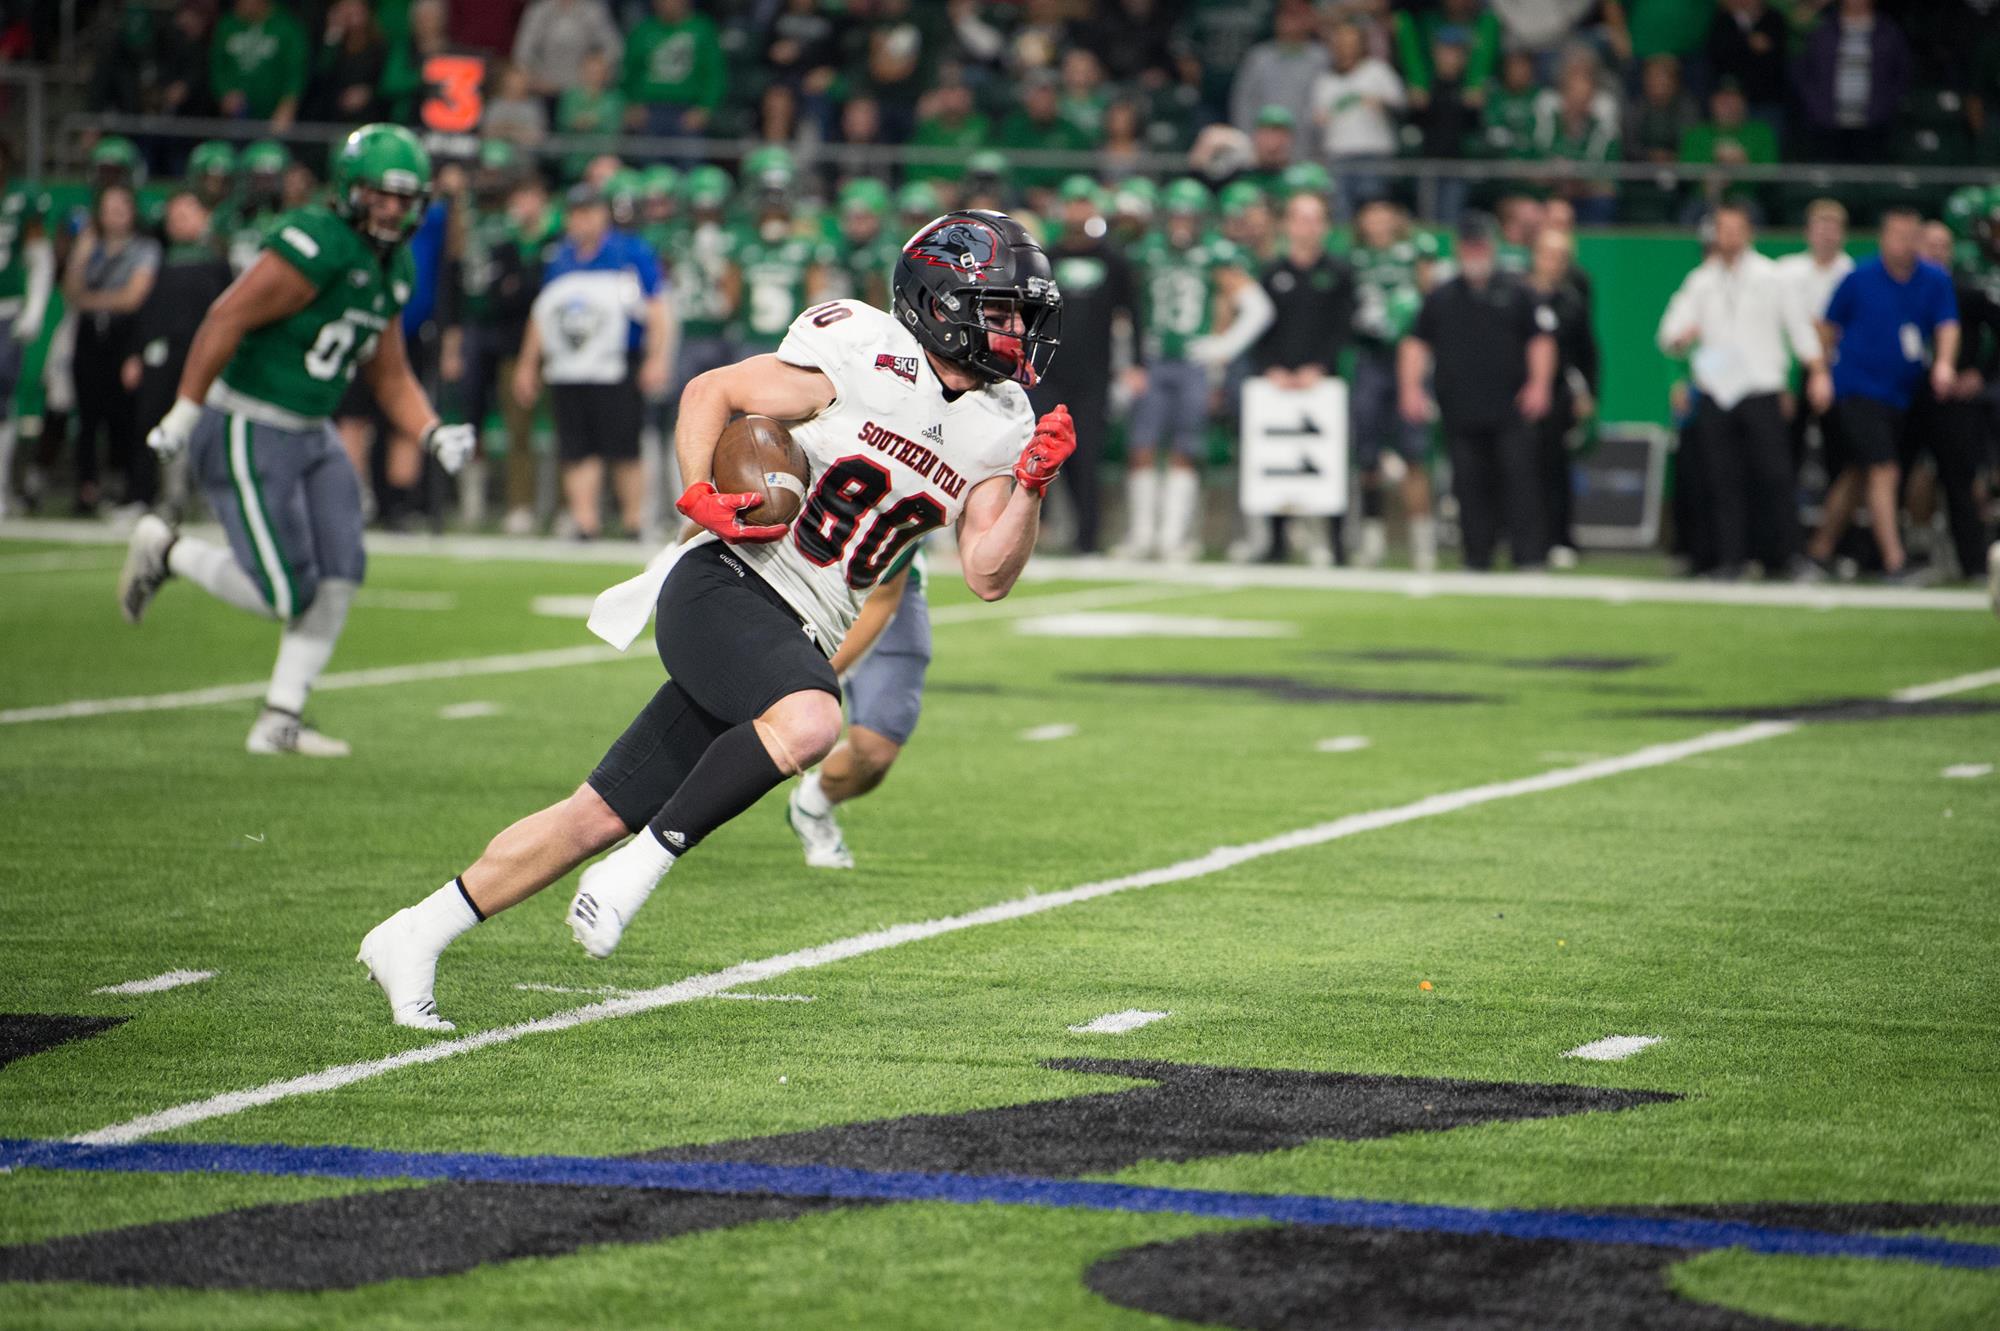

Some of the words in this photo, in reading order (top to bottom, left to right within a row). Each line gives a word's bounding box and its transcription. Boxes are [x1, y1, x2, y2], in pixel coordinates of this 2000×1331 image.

[421, 56, 484, 132] 3
[858, 421, 940, 478] SOUTHERN
[932, 461, 968, 500] UTAH
[921, 429, 944, 446] adidas
[794, 453, 947, 590] 80
